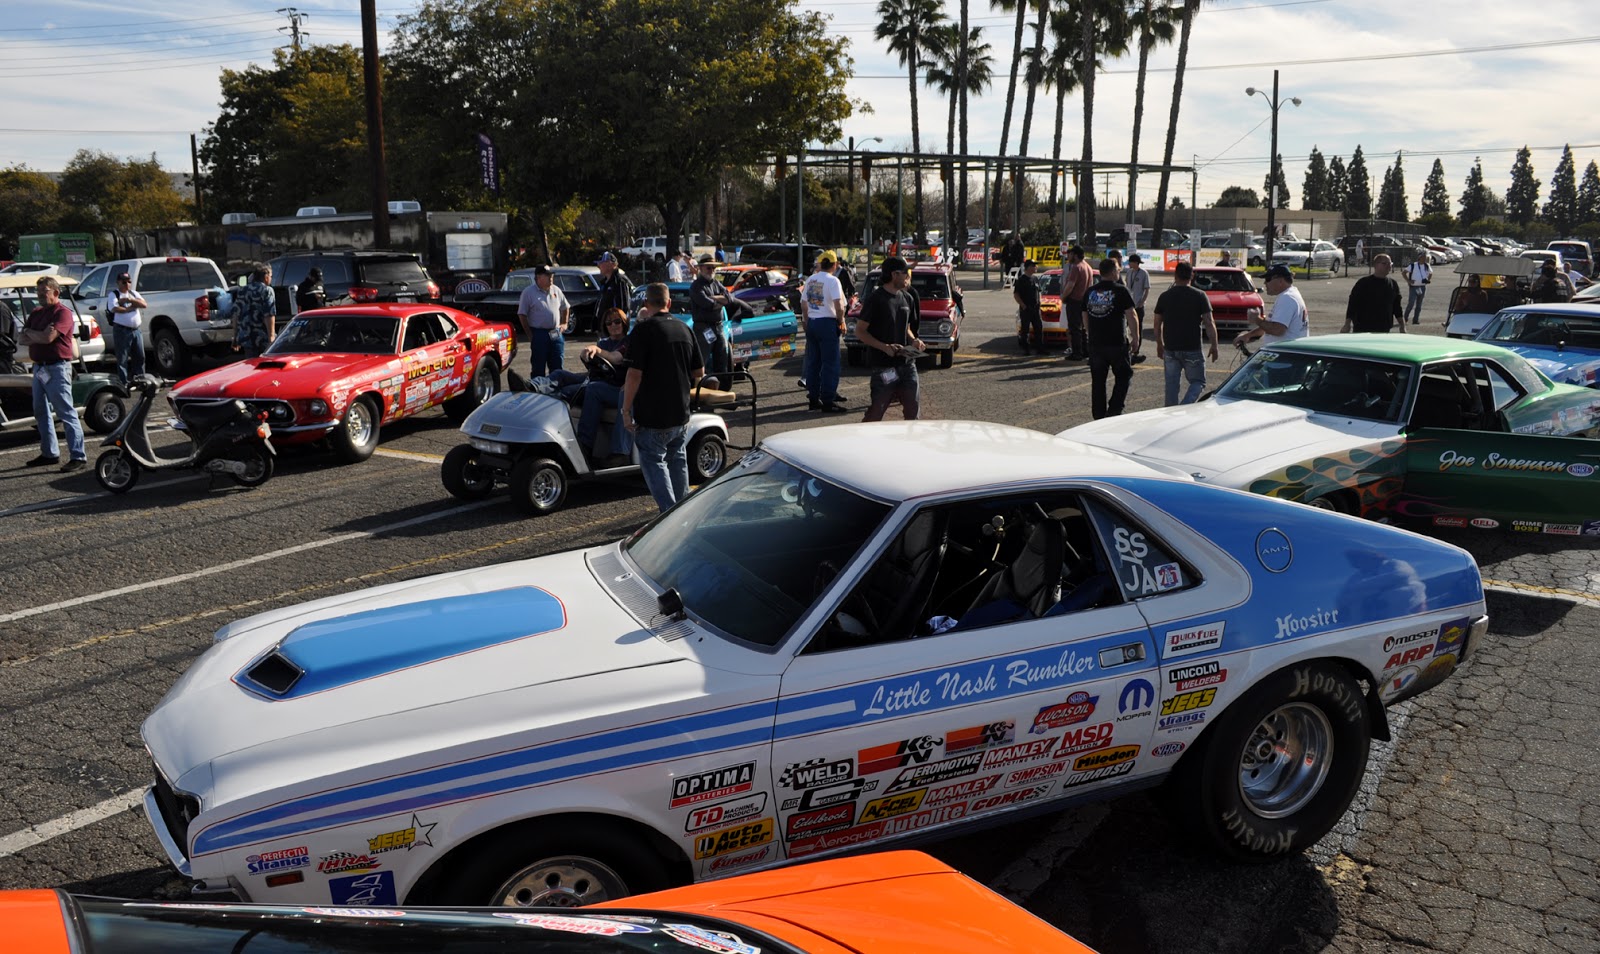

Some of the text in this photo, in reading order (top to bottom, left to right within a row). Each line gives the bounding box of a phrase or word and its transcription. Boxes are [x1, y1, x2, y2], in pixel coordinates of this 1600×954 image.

[1036, 248, 1062, 260] JEG
[407, 355, 456, 381] Moreno
[1439, 450, 1567, 472] Joe Sorensen
[1262, 545, 1290, 555] AMX
[1274, 607, 1339, 639] Hoosier
[1383, 644, 1434, 670] ARP
[1171, 664, 1218, 681] LINCOLN
[863, 650, 1094, 717] Little Nash Rumbler
[1181, 675, 1222, 690] WELDERS
[1038, 703, 1090, 723] LUCAS OIL
[1116, 710, 1152, 722] MOPAR
[1159, 711, 1206, 728] Strange
[1061, 722, 1114, 750] MSD
[985, 738, 1050, 764] MANLEY
[1060, 742, 1098, 754] IGNITION
[982, 752, 1050, 771] CONNECTING RODS
[1077, 749, 1136, 768] Milodon
[796, 762, 851, 785] WELD
[897, 753, 982, 785] AEROMOTIVE
[916, 767, 975, 786] Fuel Systems
[1009, 762, 1066, 783] SIMPSON
[676, 766, 750, 797] OPTIMA
[806, 775, 848, 788] RACING
[927, 777, 995, 803] MANLEY
[690, 787, 736, 802] BATTERIES
[972, 788, 1034, 811] COMP
[722, 807, 759, 821] PRODUCTS
[724, 803, 755, 815] MACHINE
[746, 814, 762, 822] ARMS
[793, 809, 848, 830] Edelbrock
[882, 804, 964, 836] Autolite
[714, 831, 770, 855] Meter
[718, 824, 763, 844] Auto
[815, 828, 880, 849] Aeroquip
[261, 847, 308, 862] PERFECTLY
[370, 844, 409, 856] ALLSTARS
[247, 856, 310, 873] Strange
[316, 855, 370, 873] IHRA
